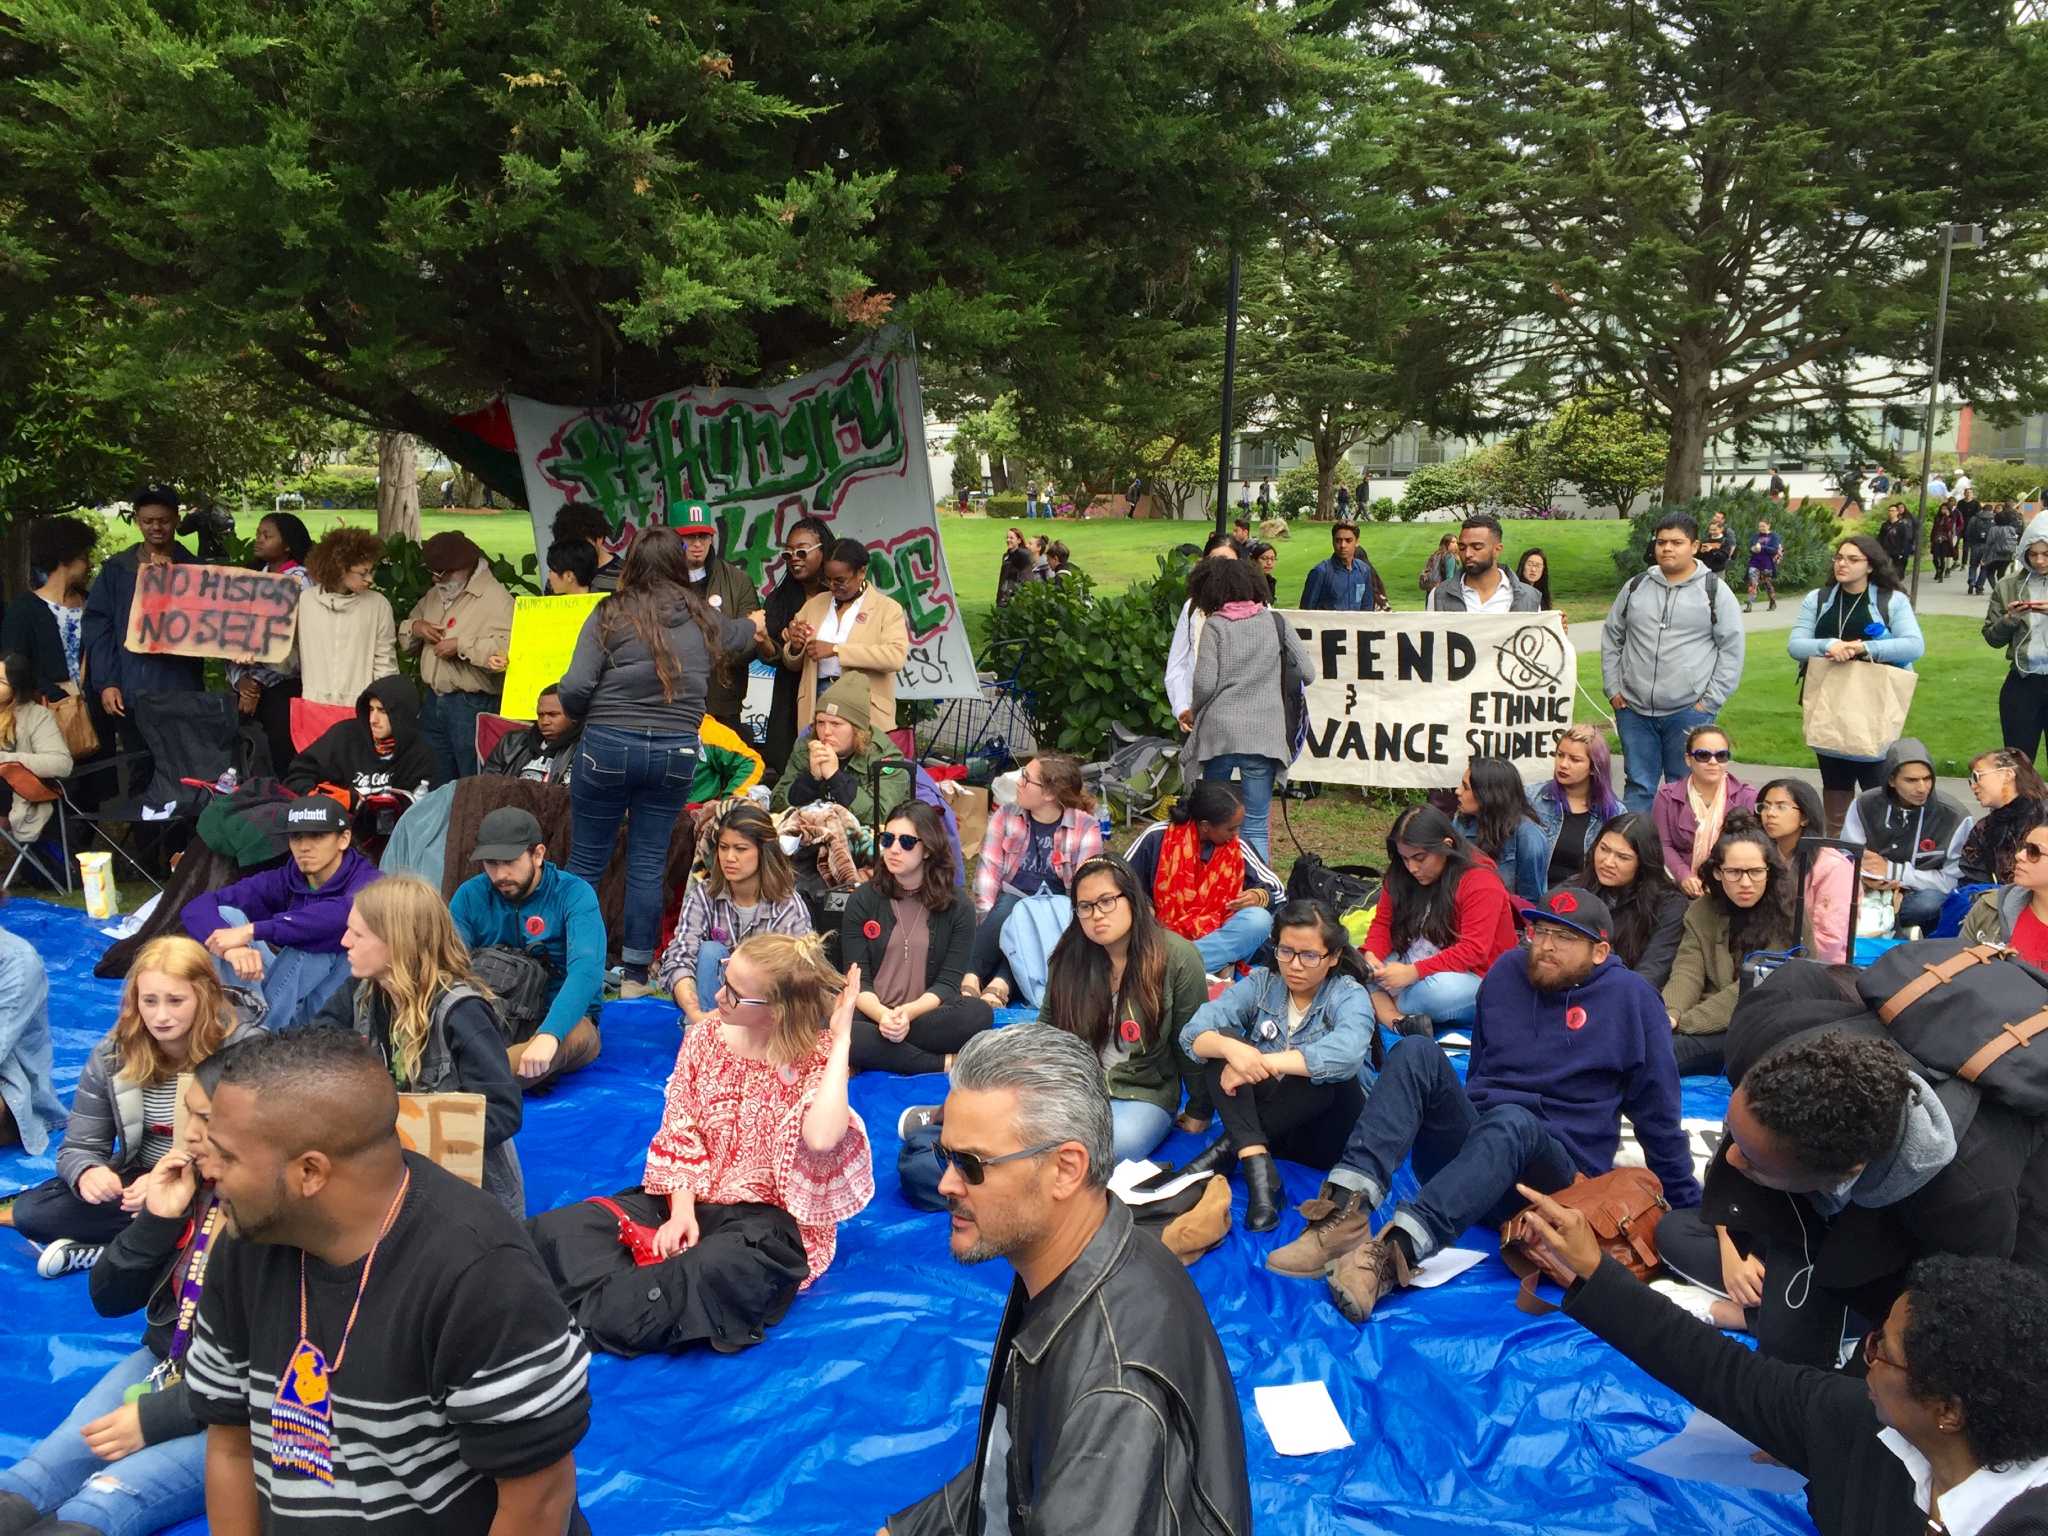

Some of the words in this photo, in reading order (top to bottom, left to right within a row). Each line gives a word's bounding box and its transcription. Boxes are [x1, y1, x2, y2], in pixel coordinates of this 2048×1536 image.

[143, 565, 191, 596] NO
[139, 610, 191, 643] NO
[194, 609, 292, 656] SELF
